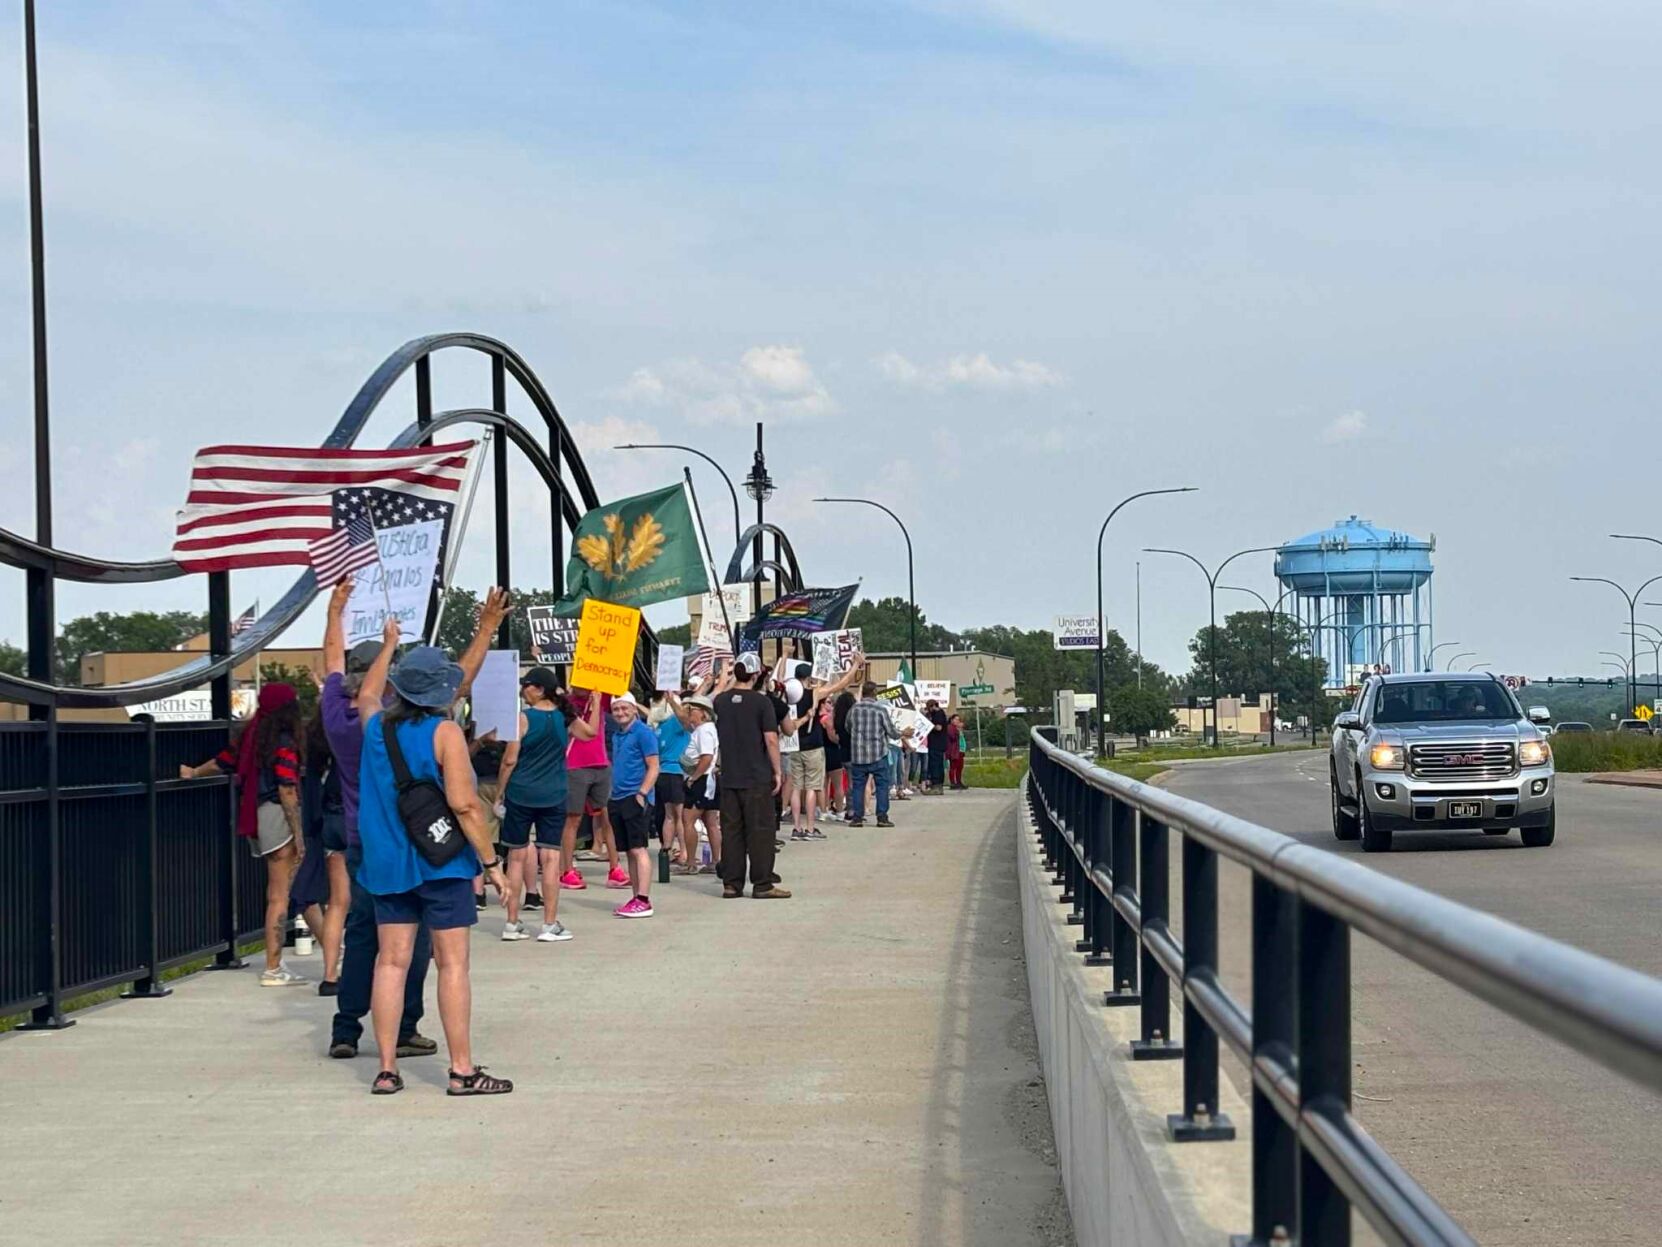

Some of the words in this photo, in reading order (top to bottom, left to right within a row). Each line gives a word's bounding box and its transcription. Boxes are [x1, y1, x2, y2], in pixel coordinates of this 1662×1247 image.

[587, 606, 633, 627] Stand
[1058, 617, 1098, 627] University
[533, 618, 563, 631] THE
[599, 626, 616, 642] up
[1064, 627, 1097, 636] Avenue
[535, 632, 550, 645] IS
[585, 637, 607, 655] for
[576, 656, 632, 682] Democracy
[1443, 754, 1484, 765] GMC
